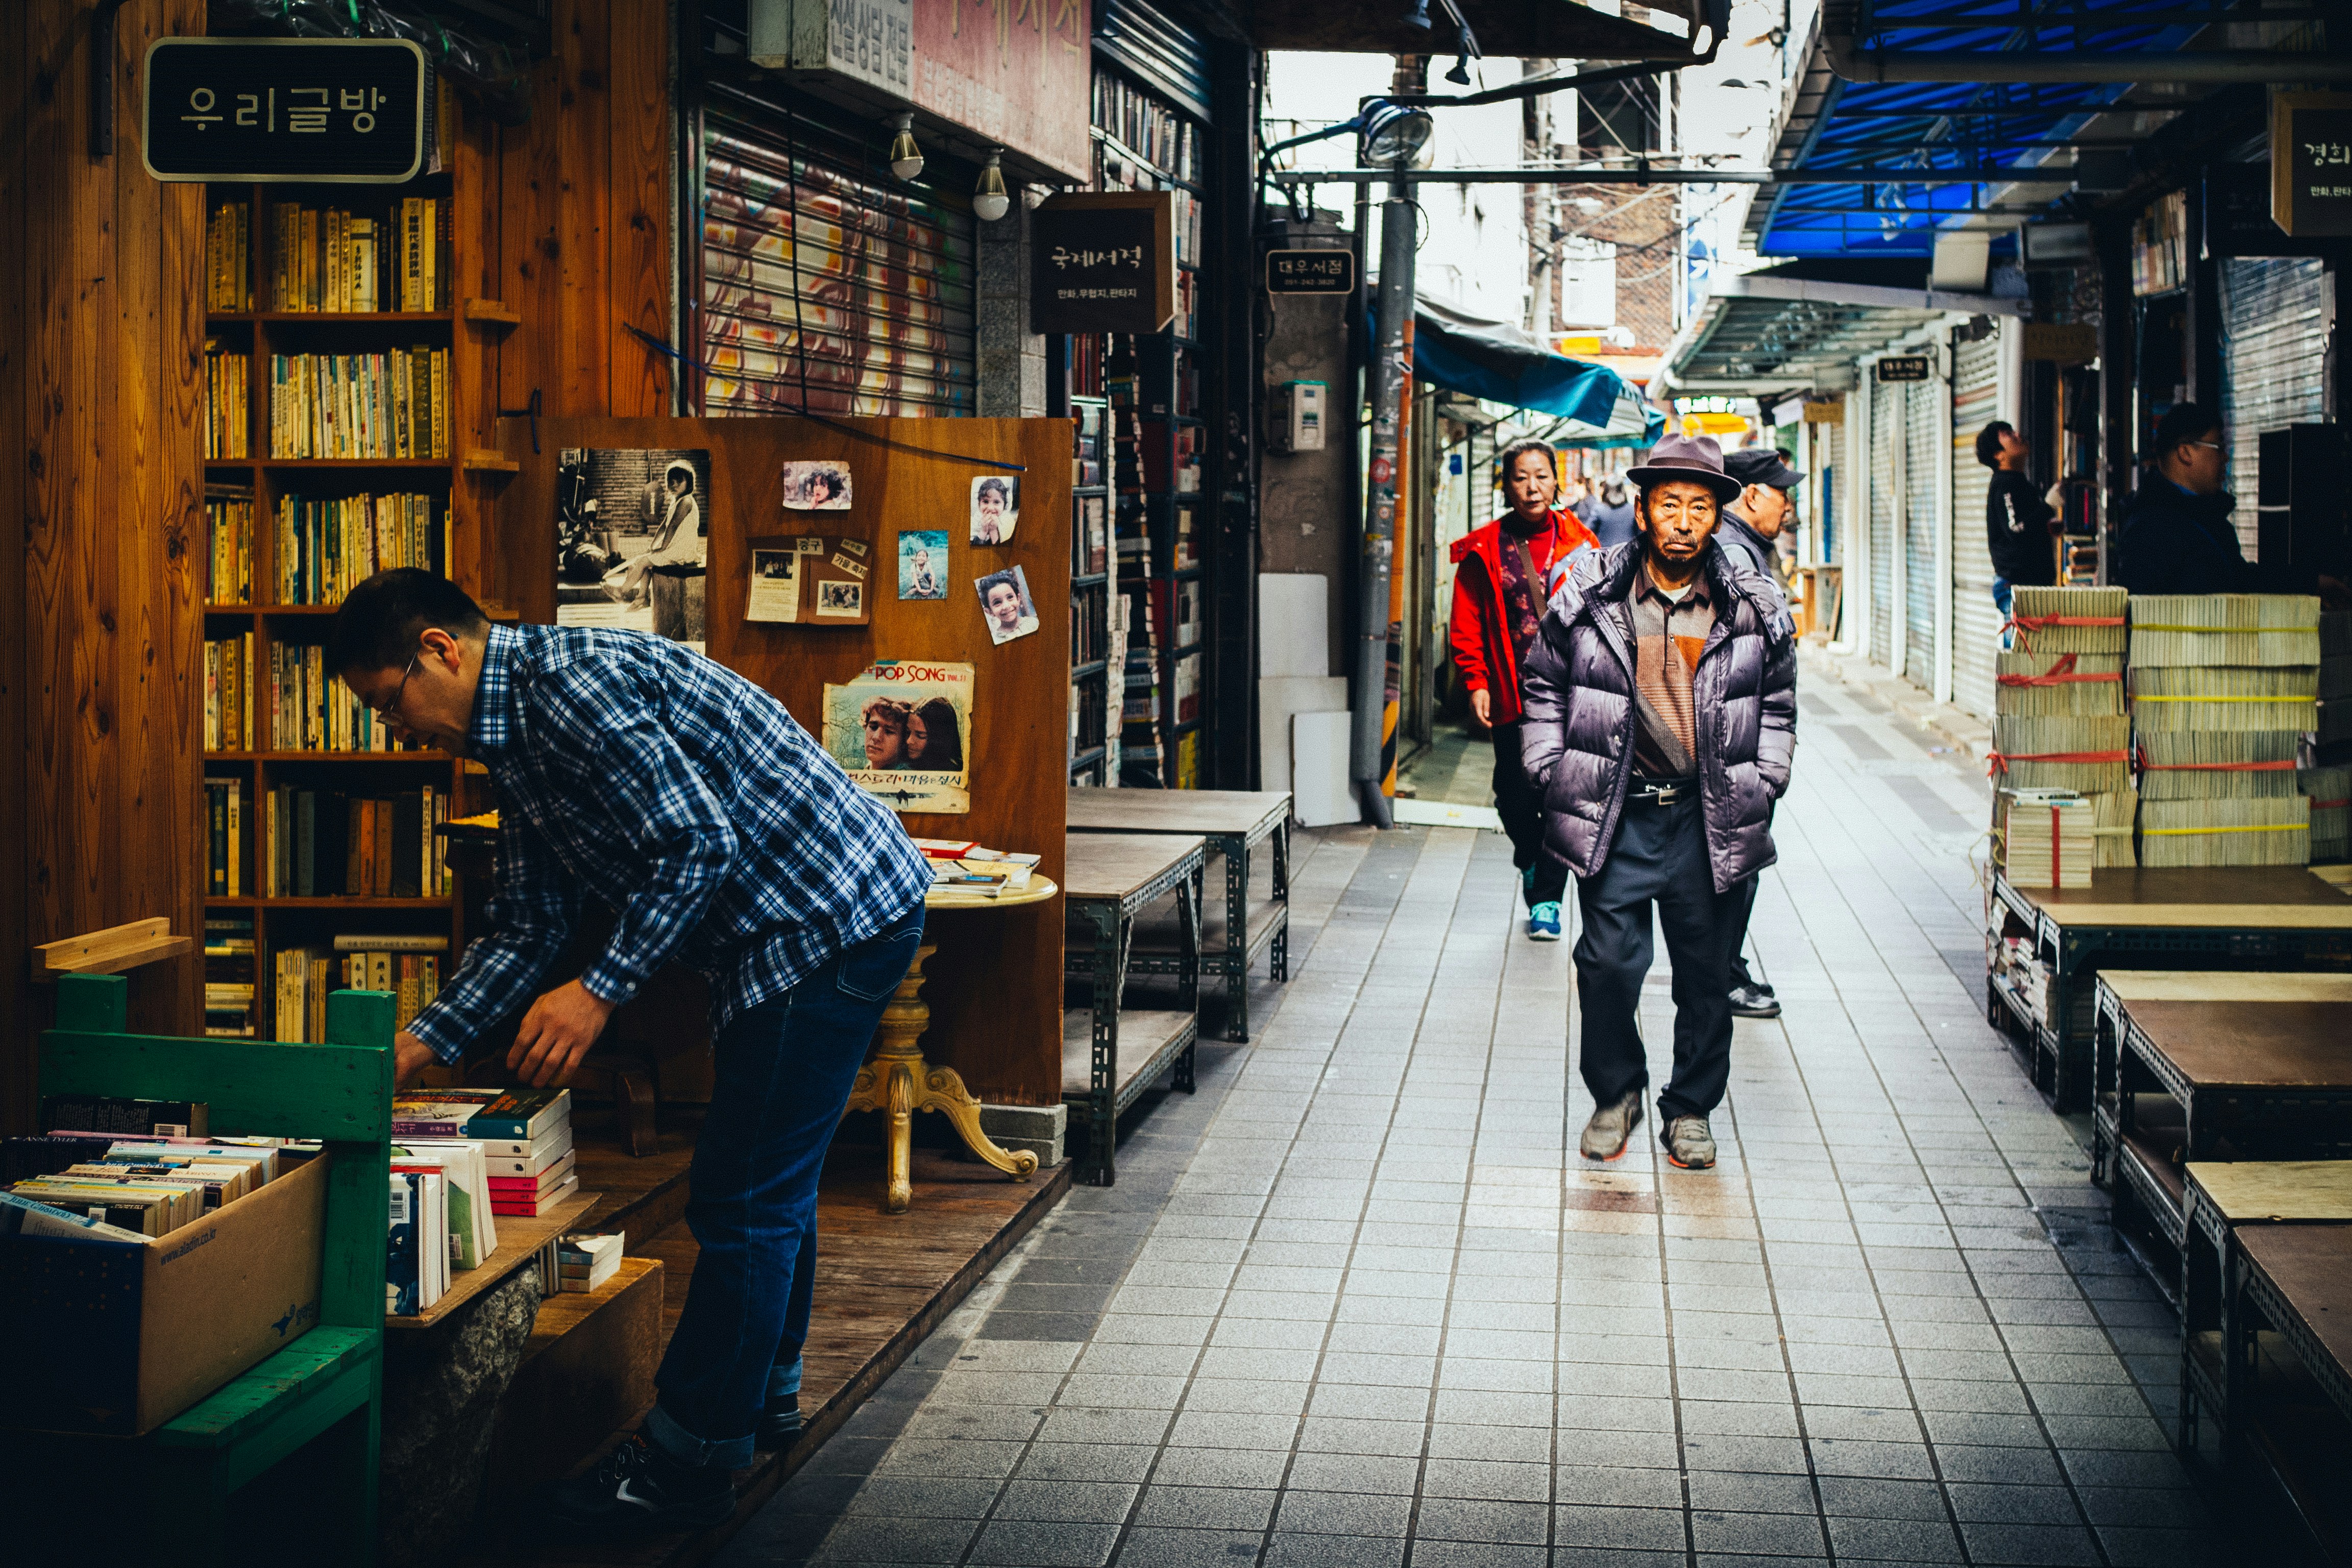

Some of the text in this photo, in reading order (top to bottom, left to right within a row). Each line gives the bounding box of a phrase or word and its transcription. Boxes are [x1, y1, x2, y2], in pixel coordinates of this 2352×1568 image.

[181, 87, 387, 133] 우리글방
[1051, 246, 1141, 270] 국제서적
[1279, 259, 1342, 274] 대우서점
[799, 540, 820, 551] 중구
[875, 666, 904, 680] POP
[906, 665, 946, 683] SONG
[161, 1228, 216, 1266] www.aladin.co.kr
